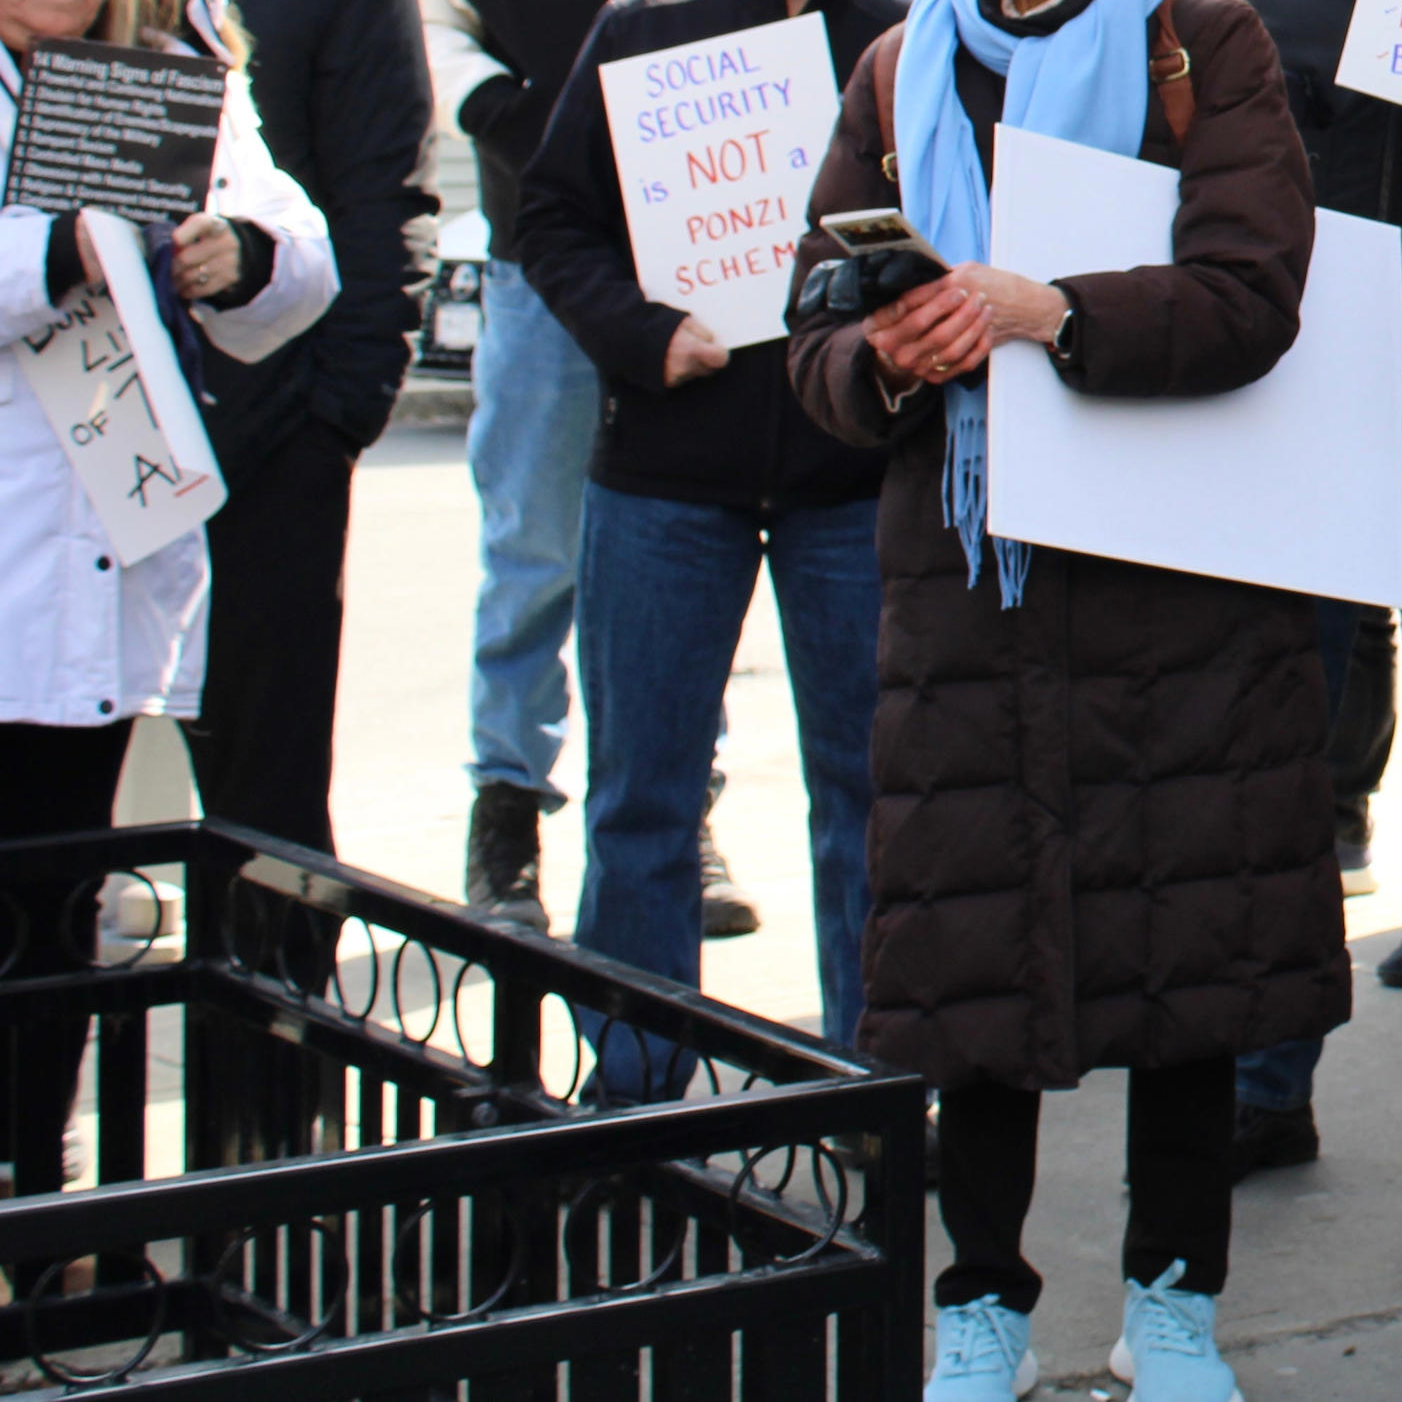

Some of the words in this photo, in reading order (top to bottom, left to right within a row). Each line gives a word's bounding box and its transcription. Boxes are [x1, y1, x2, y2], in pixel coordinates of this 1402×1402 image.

[645, 46, 760, 99] SOCIAL
[638, 77, 792, 143] SECURITY
[640, 178, 669, 204] is
[686, 129, 771, 190] NOT
[788, 146, 809, 169] a
[686, 196, 787, 245] PONZI
[675, 240, 797, 295] SCHEM
